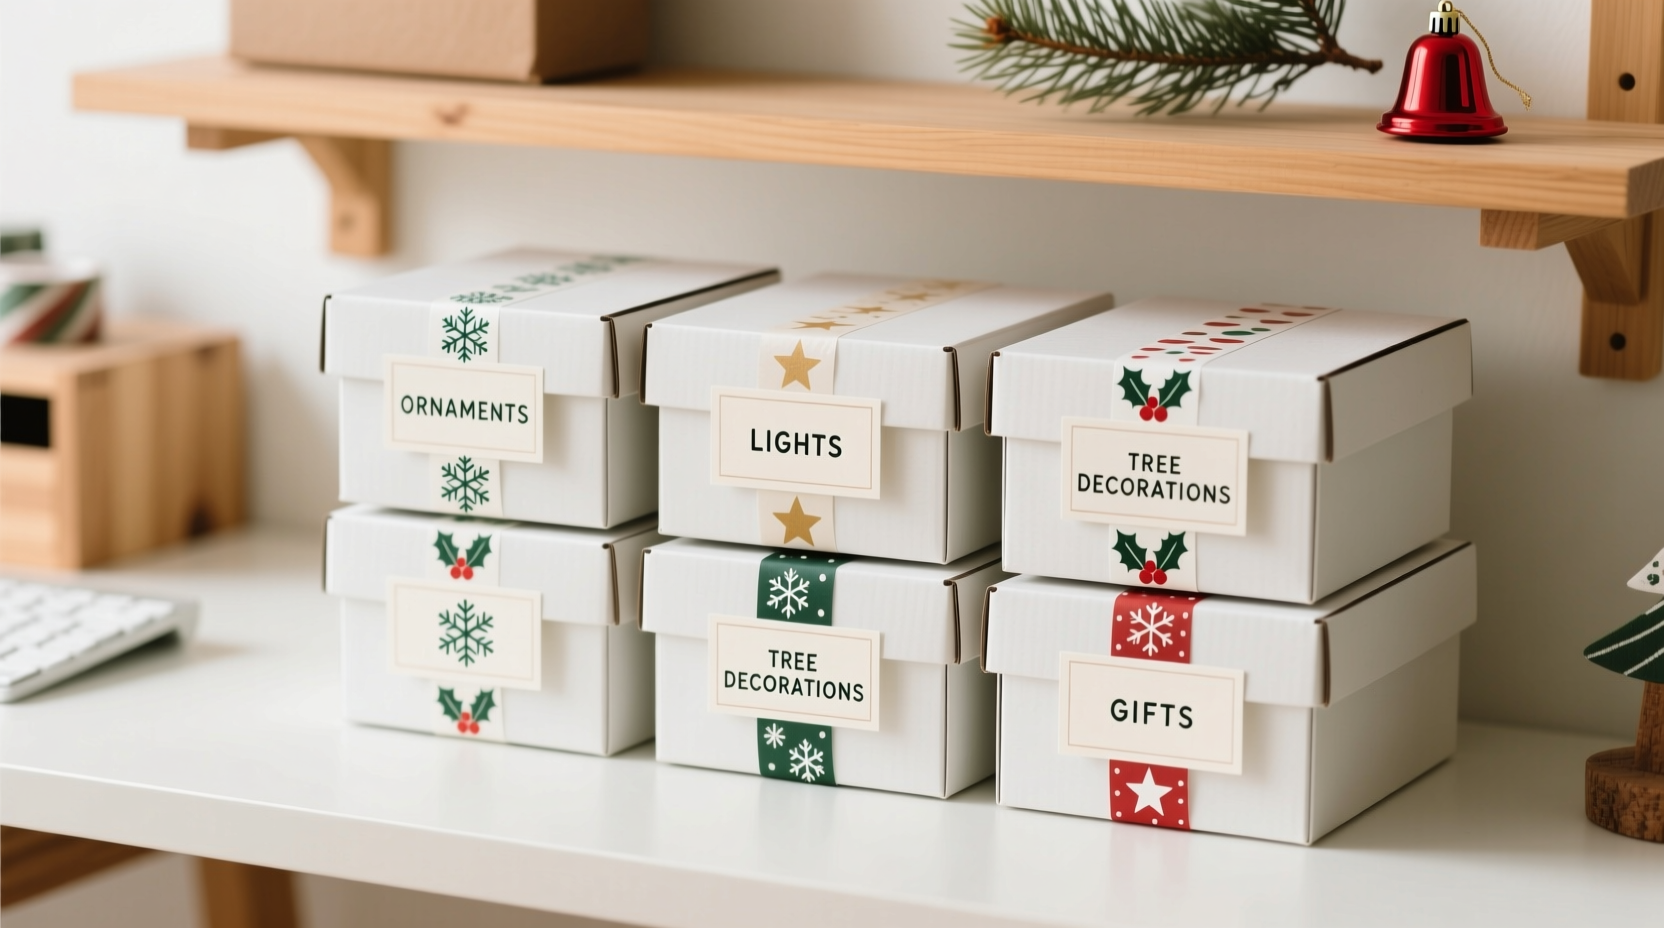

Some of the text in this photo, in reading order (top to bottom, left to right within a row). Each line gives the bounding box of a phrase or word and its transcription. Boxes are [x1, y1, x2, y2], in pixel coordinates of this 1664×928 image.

[400, 394, 529, 425] ORNAMENTS
[751, 428, 843, 459] LIGHTS
[1128, 452, 1181, 475] TREE
[1077, 472, 1231, 505] DECORATIONS
[768, 649, 818, 673] TREE
[724, 670, 864, 703] DECORATIONS
[1110, 698, 1193, 730] GIFTS
